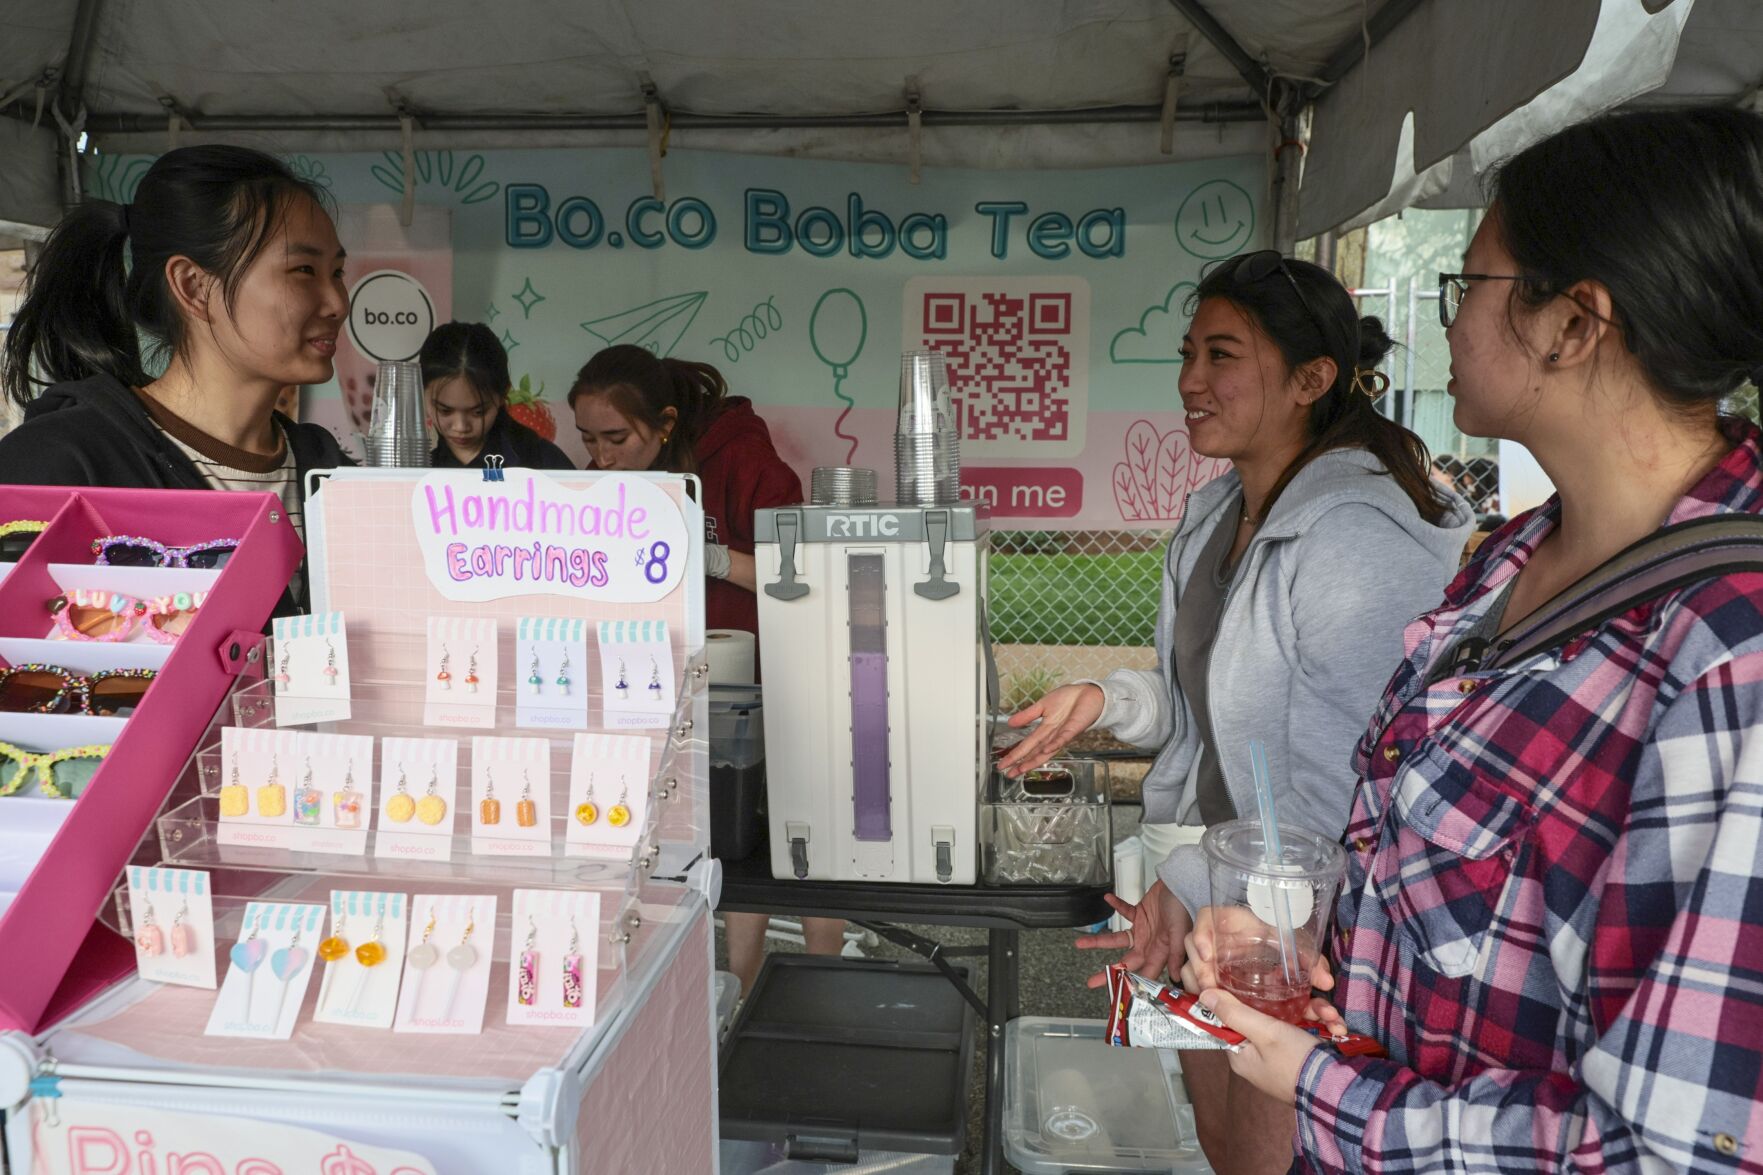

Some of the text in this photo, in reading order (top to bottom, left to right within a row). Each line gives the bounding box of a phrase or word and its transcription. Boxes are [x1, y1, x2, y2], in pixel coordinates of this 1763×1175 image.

[505, 183, 1125, 260] Bo.co Boba Tea
[365, 307, 418, 325] bo.co
[425, 477, 650, 540] Handmade
[1011, 485, 1066, 508] me
[826, 514, 899, 537] RTIC
[446, 541, 609, 588] Earrings
